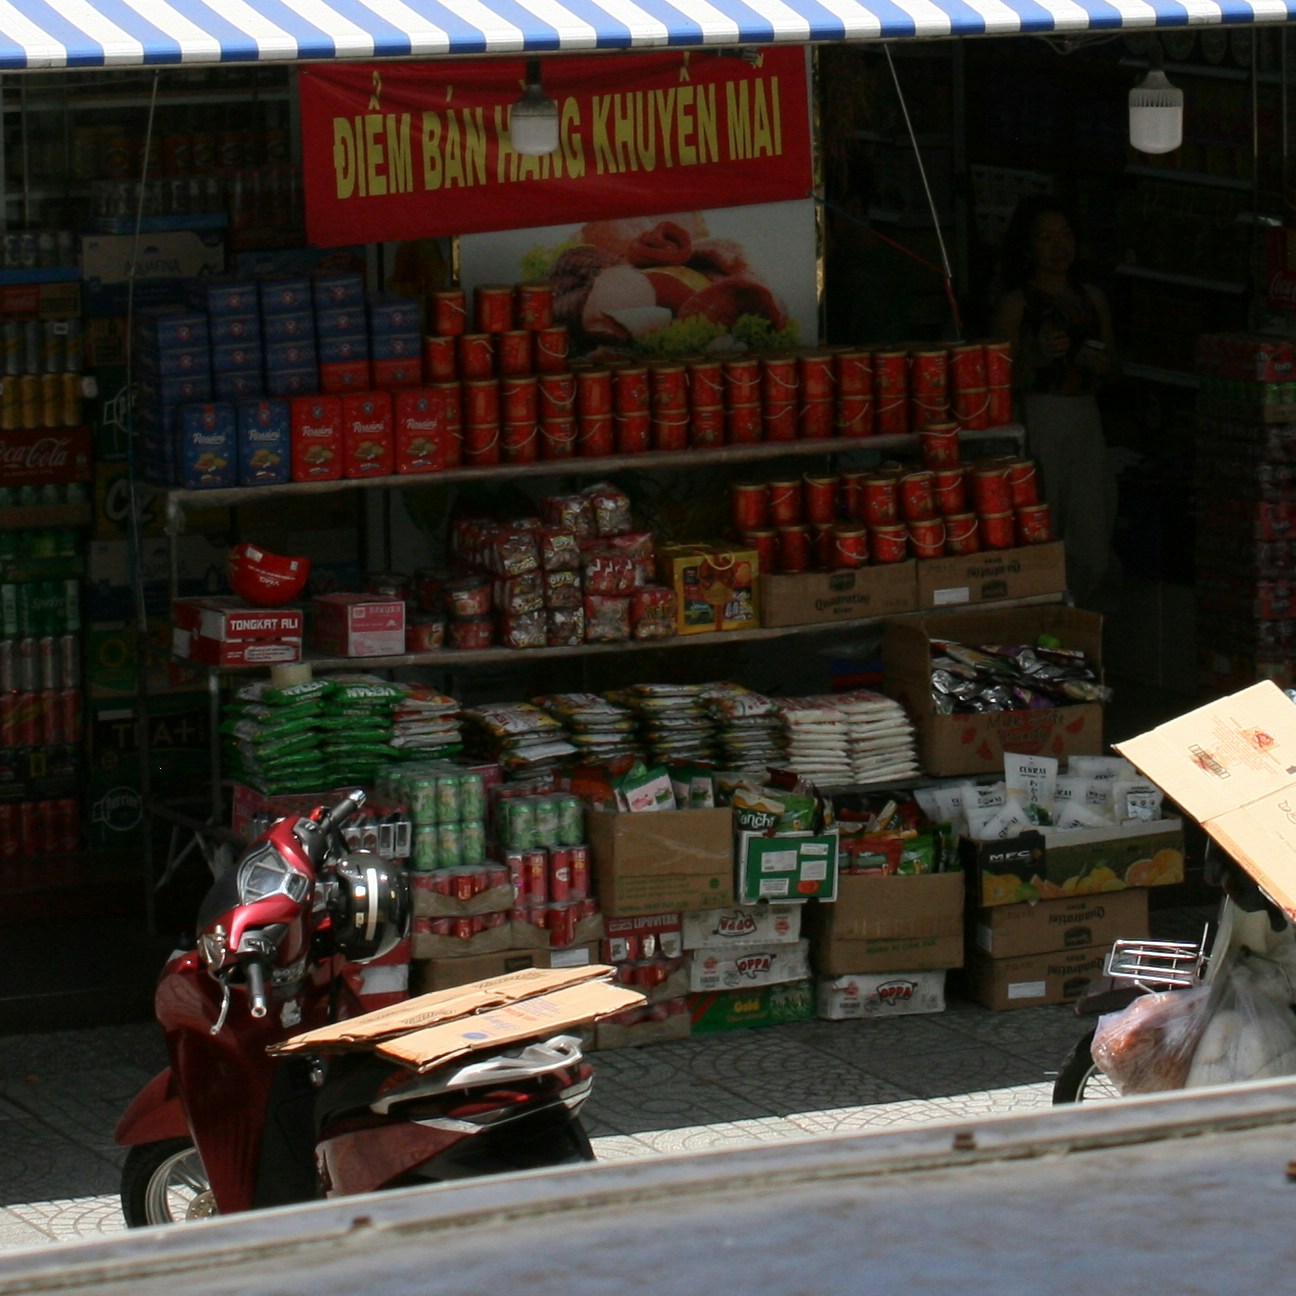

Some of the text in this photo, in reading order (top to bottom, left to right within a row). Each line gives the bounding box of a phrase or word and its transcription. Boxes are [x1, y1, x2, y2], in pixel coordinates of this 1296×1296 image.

[333, 71, 414, 199] ĐIỂM
[422, 85, 487, 191] BÁN
[231, 618, 298, 630] TONGKAT ALI
[111, 723, 197, 749] TA+
[719, 918, 753, 932] OPPA
[738, 957, 770, 972] OPPA
[879, 985, 915, 999] OPPA
